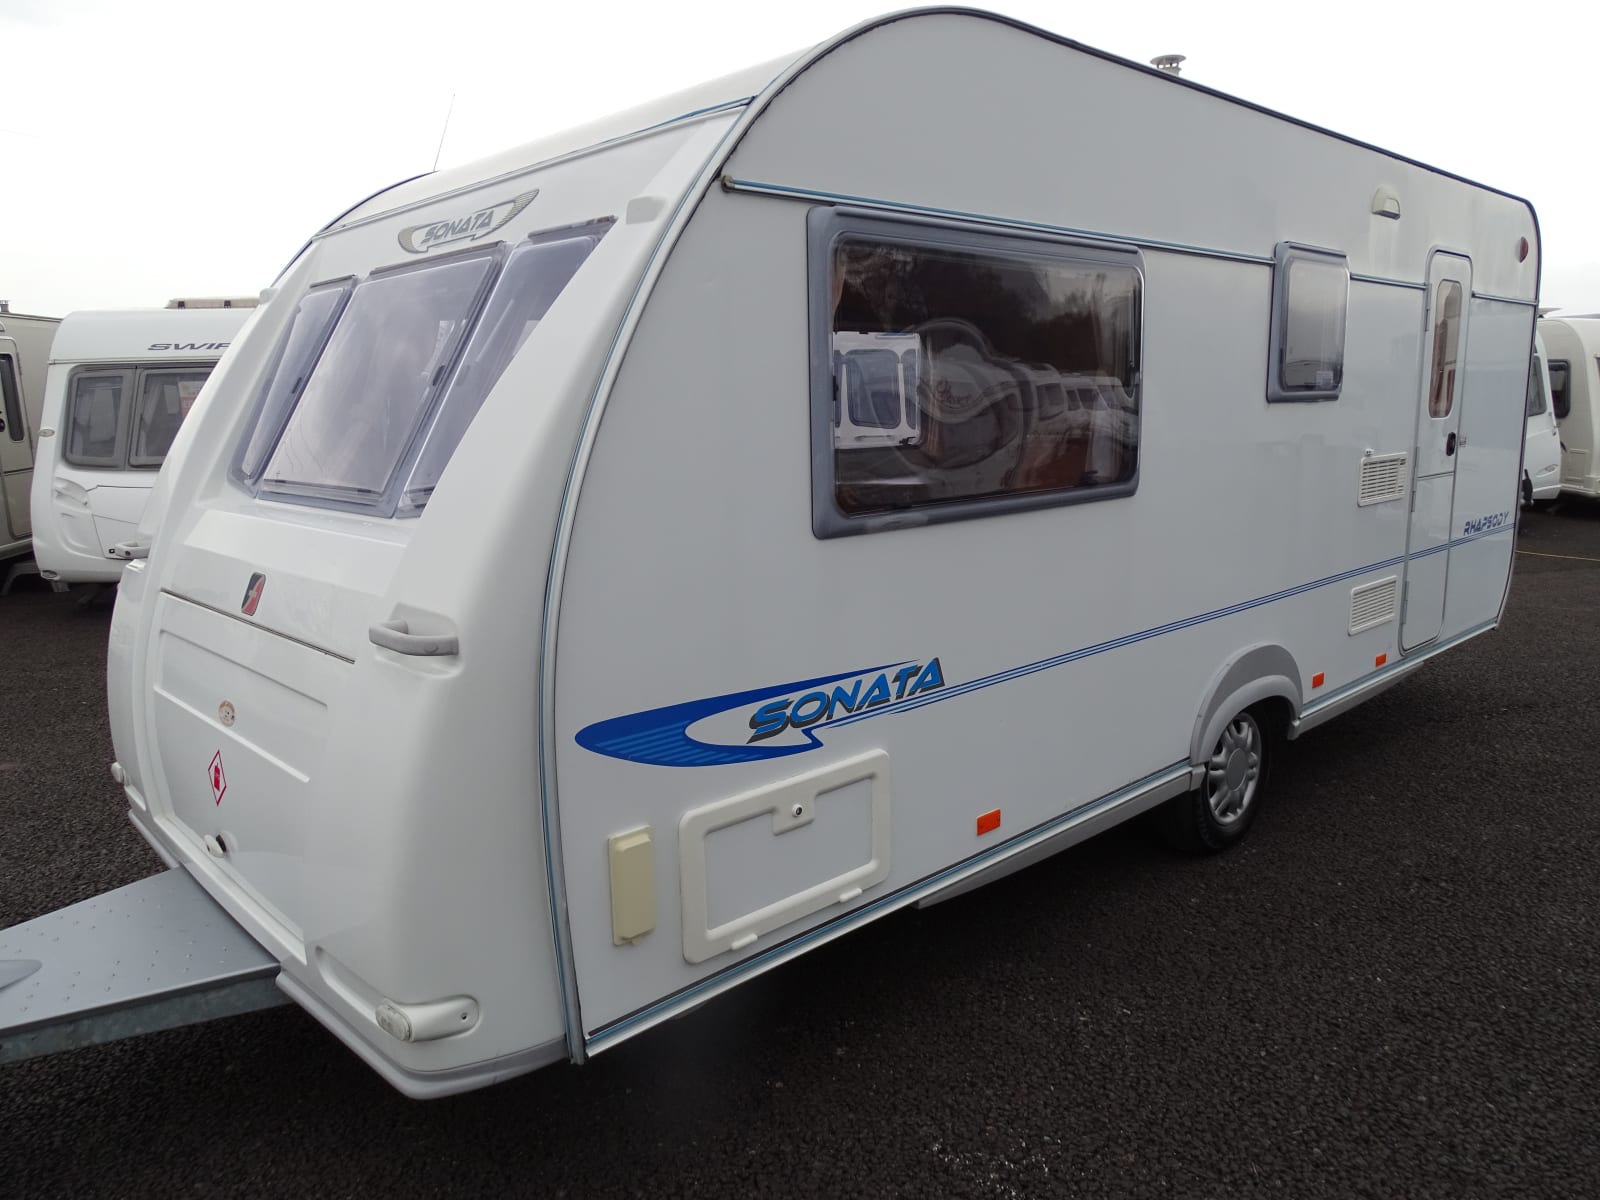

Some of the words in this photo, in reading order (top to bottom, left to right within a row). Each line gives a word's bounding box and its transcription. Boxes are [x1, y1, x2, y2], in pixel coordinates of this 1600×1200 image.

[420, 210, 494, 245] SONATA
[147, 342, 231, 351] SWIF
[1463, 511, 1509, 536] RHAPSODY
[746, 657, 945, 744] SONATA
